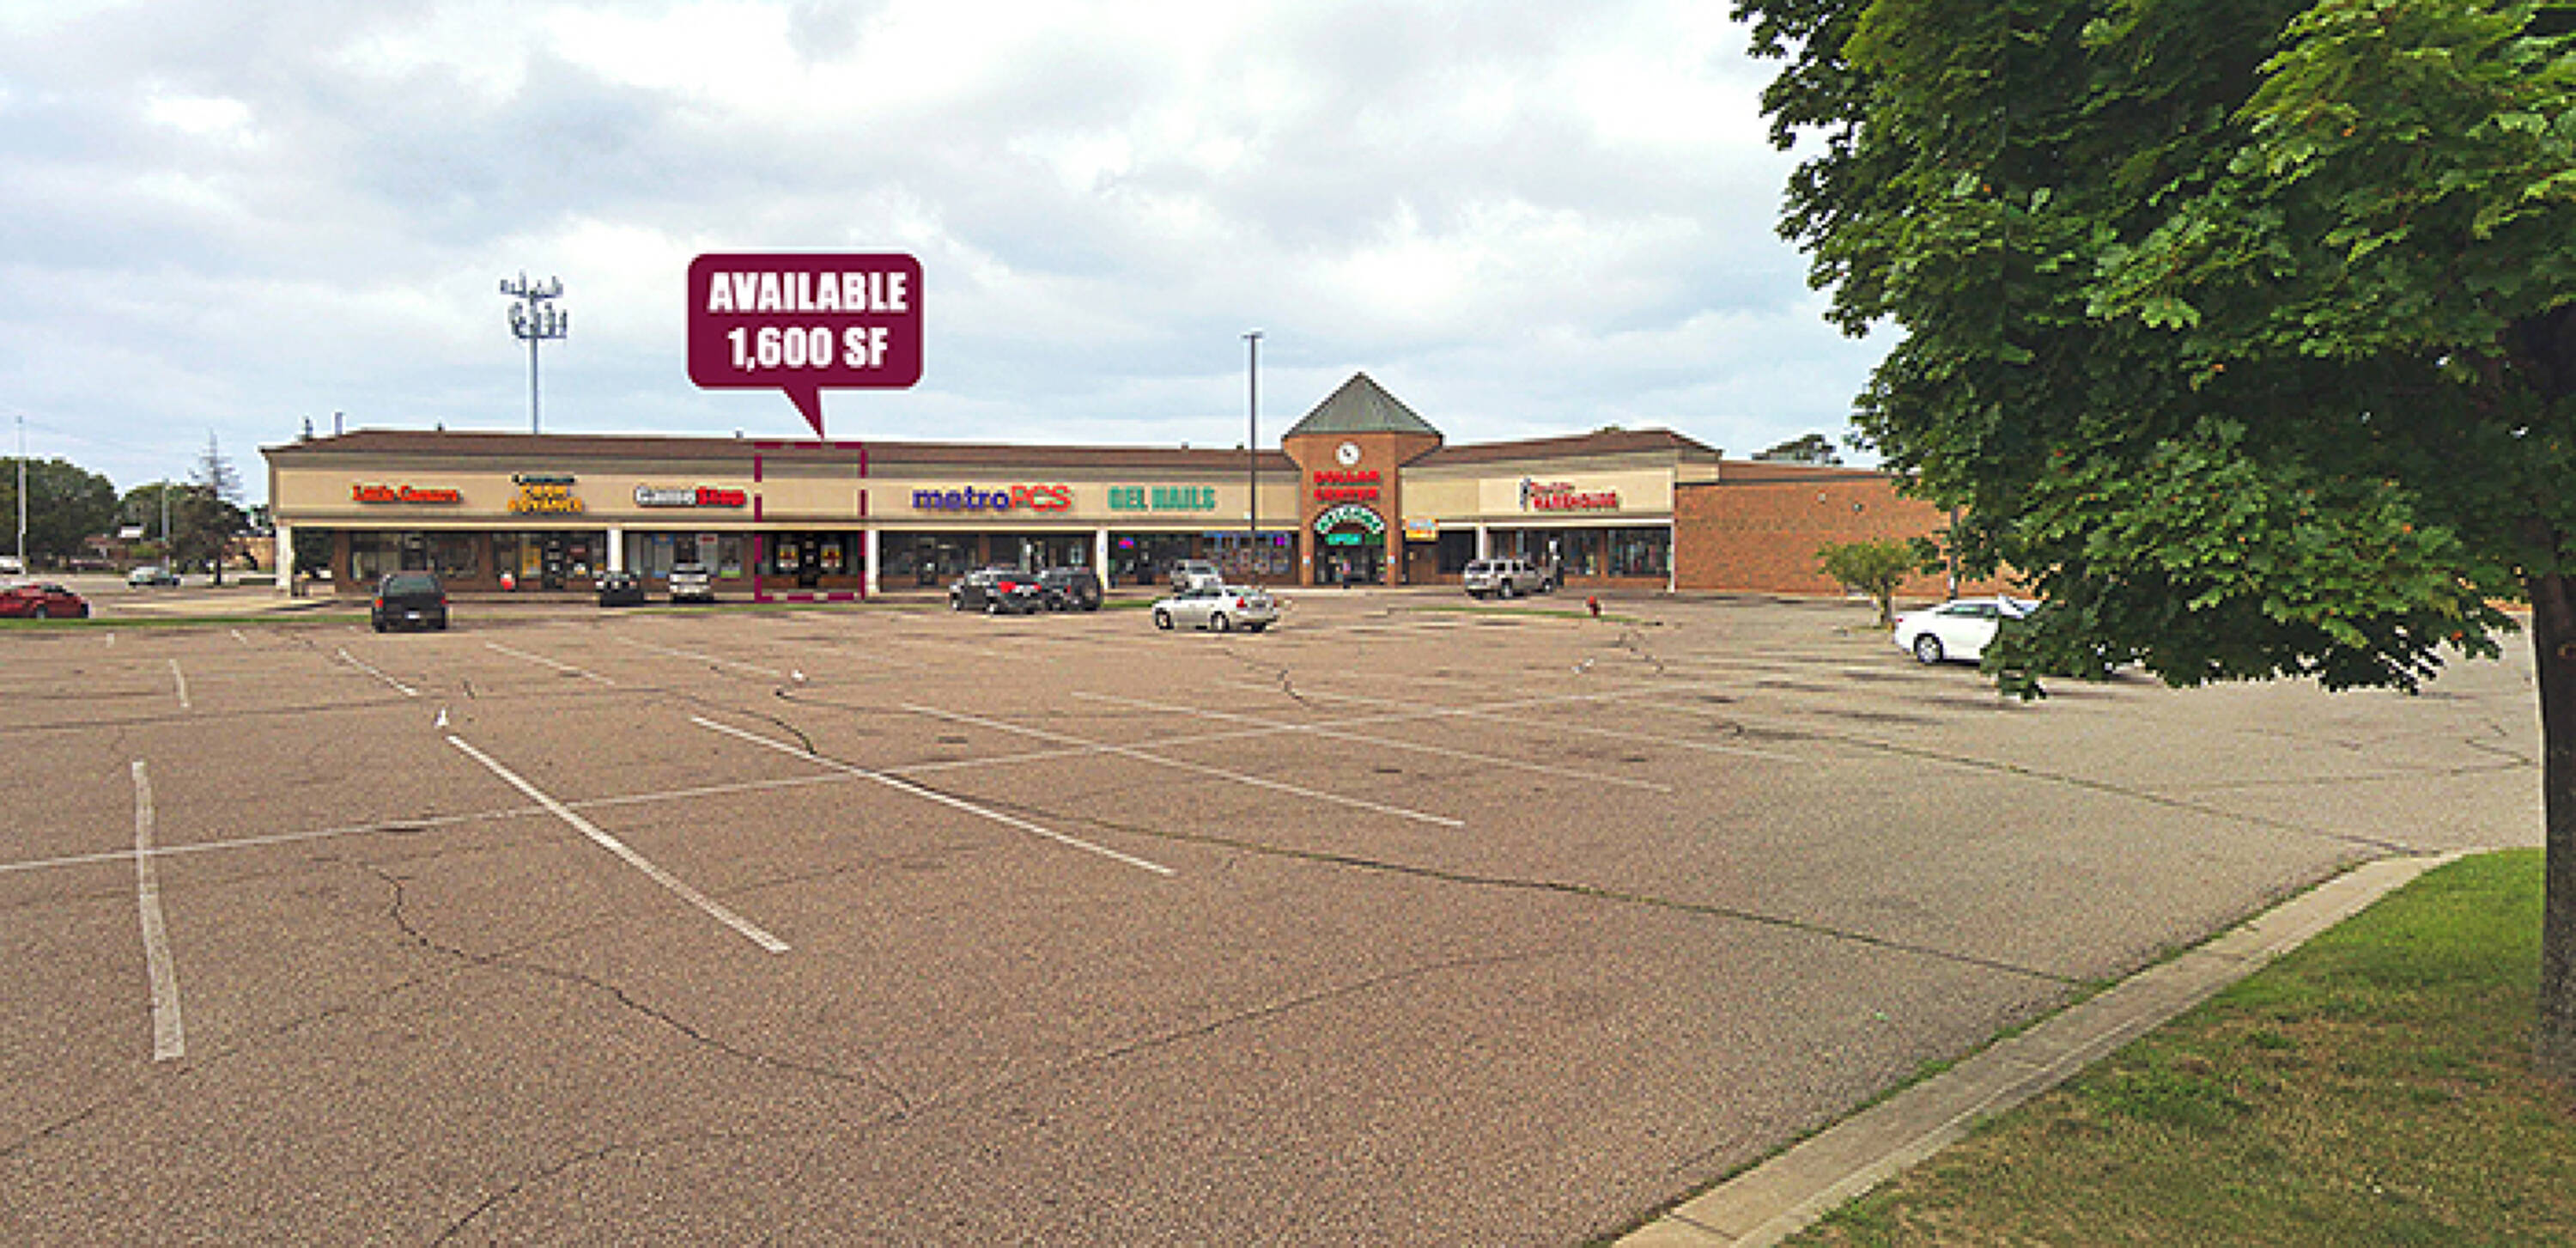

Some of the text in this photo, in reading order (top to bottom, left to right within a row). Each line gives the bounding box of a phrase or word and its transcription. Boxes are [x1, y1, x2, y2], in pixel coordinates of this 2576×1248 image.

[1312, 470, 1382, 484] DOLLAR
[635, 484, 745, 507] GameStop
[912, 485, 1072, 513] metroPCS
[1151, 485, 1215, 511] NAILS
